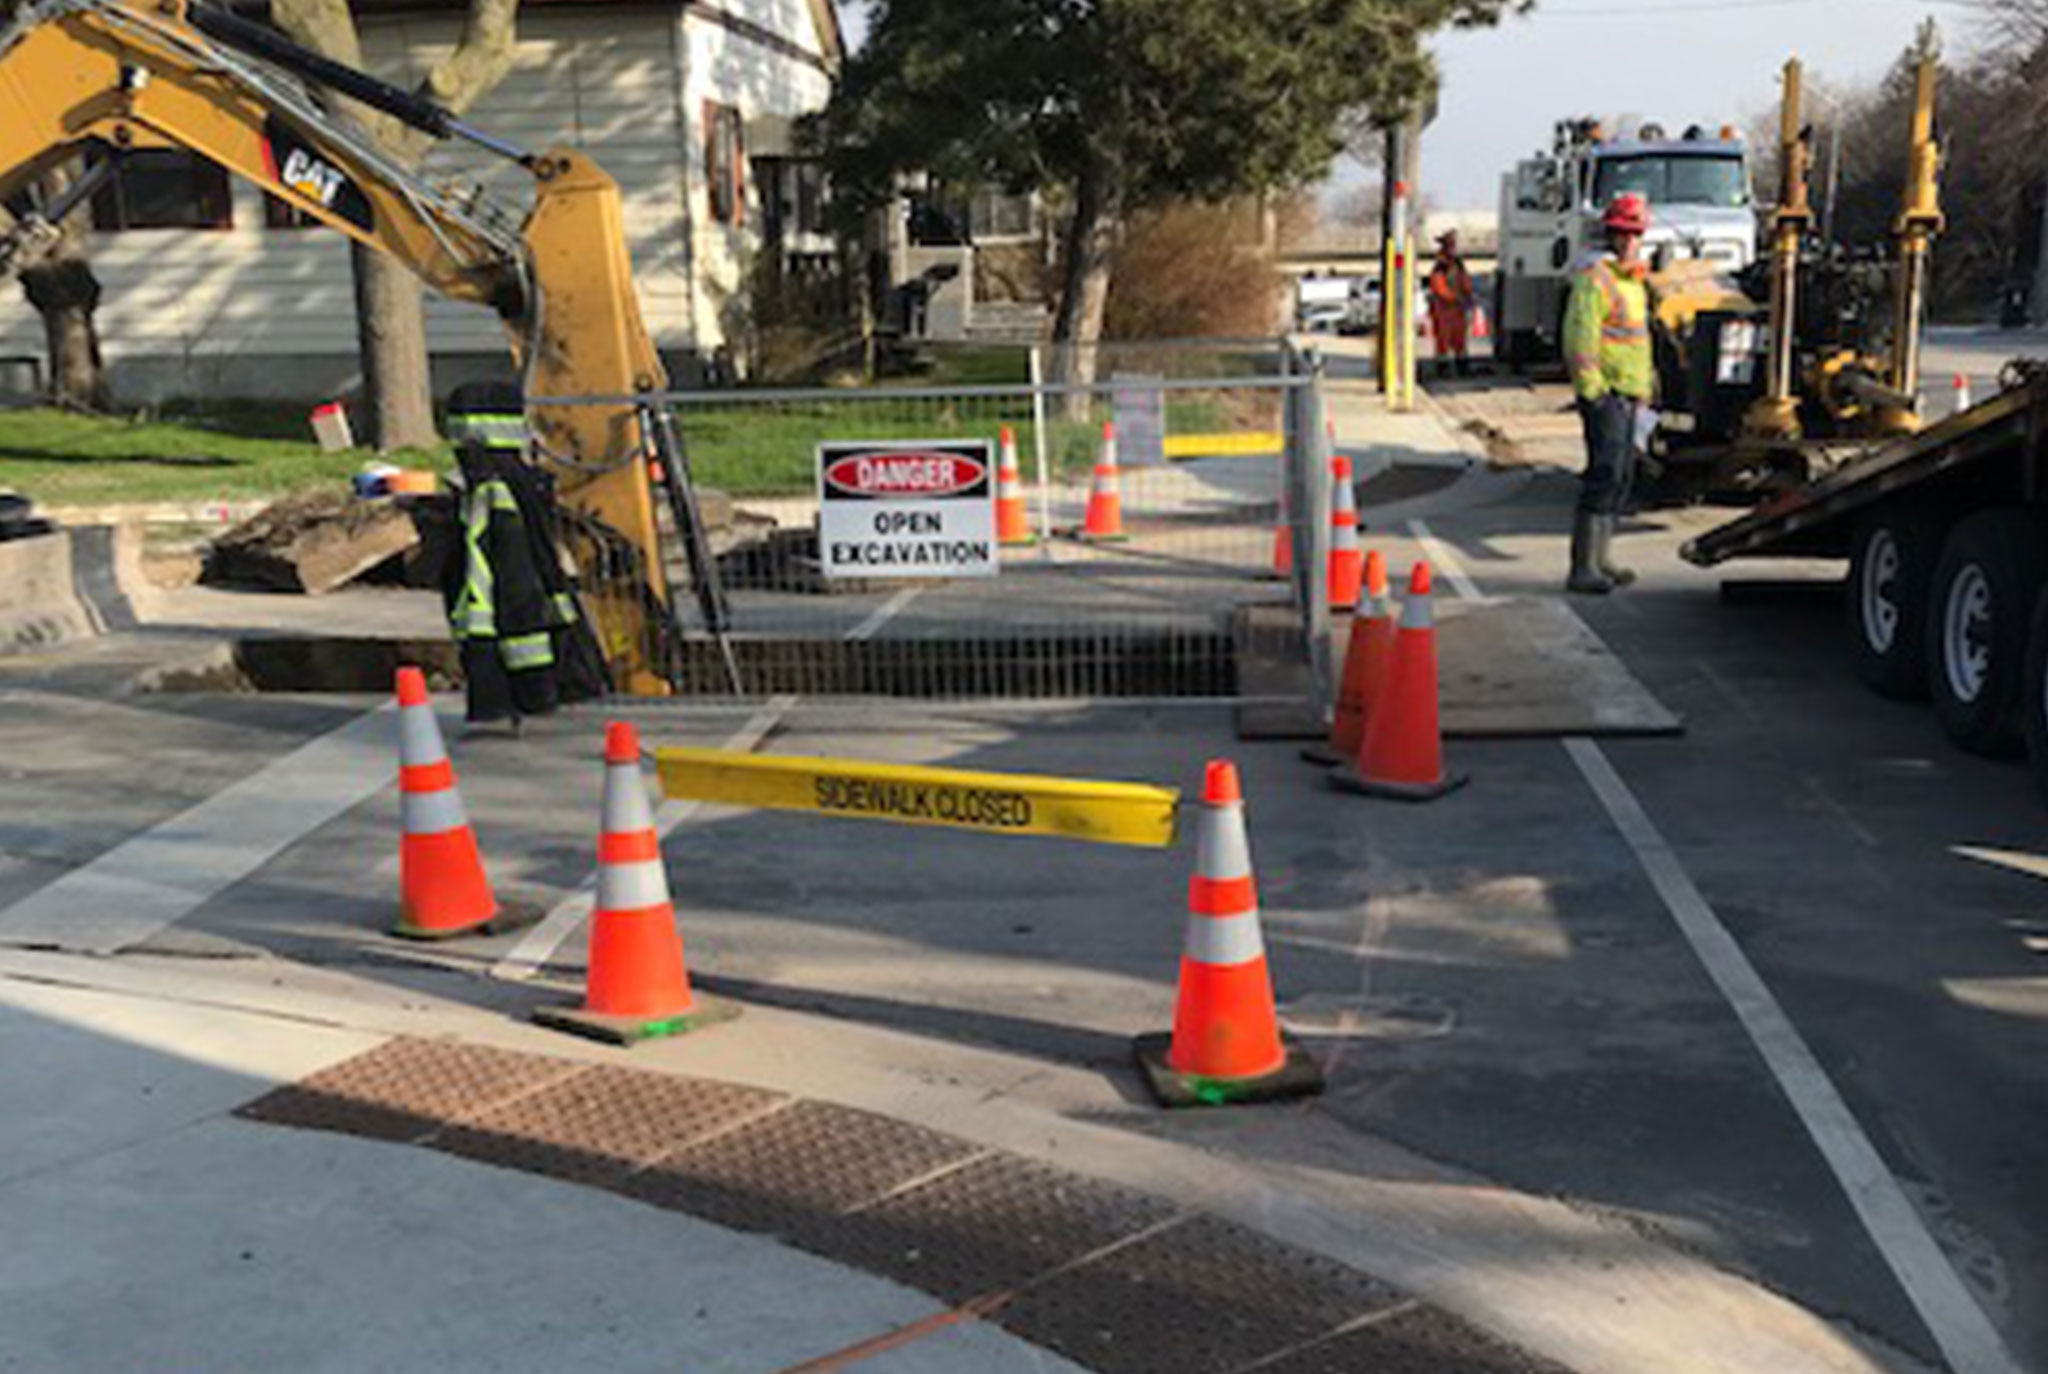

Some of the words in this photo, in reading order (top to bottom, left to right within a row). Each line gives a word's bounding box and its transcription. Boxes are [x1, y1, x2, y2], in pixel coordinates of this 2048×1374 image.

[283, 147, 344, 205] CAT
[856, 458, 955, 488] DANGER
[874, 511, 942, 534] OPEN
[831, 541, 989, 565] EXCAVATION
[815, 775, 932, 818] SIDEWALK
[934, 785, 1032, 826] CLOSED
